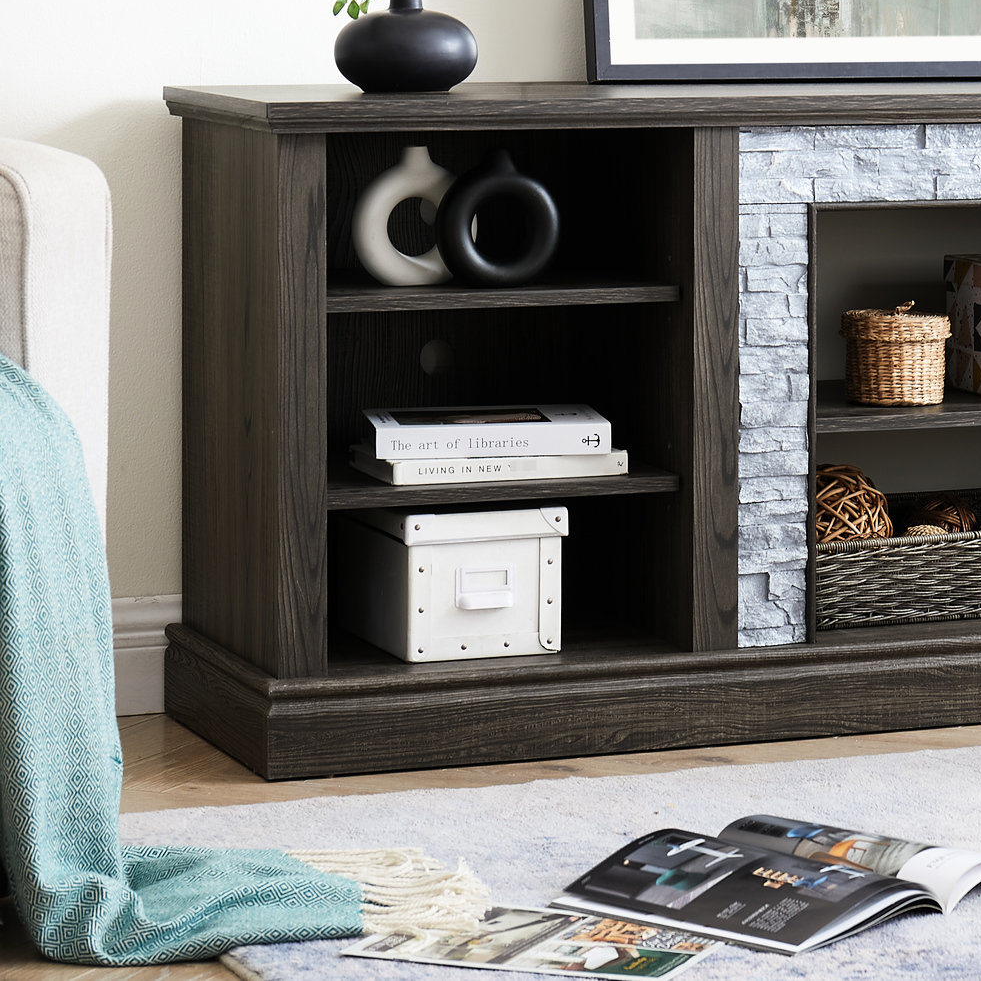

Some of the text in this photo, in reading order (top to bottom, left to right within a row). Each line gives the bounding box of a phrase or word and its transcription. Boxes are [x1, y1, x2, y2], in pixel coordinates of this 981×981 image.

[390, 437, 530, 452] The art of libraries
[418, 465, 455, 475] LIVING
[461, 465, 473, 473] IN
[478, 464, 502, 473] NEW
